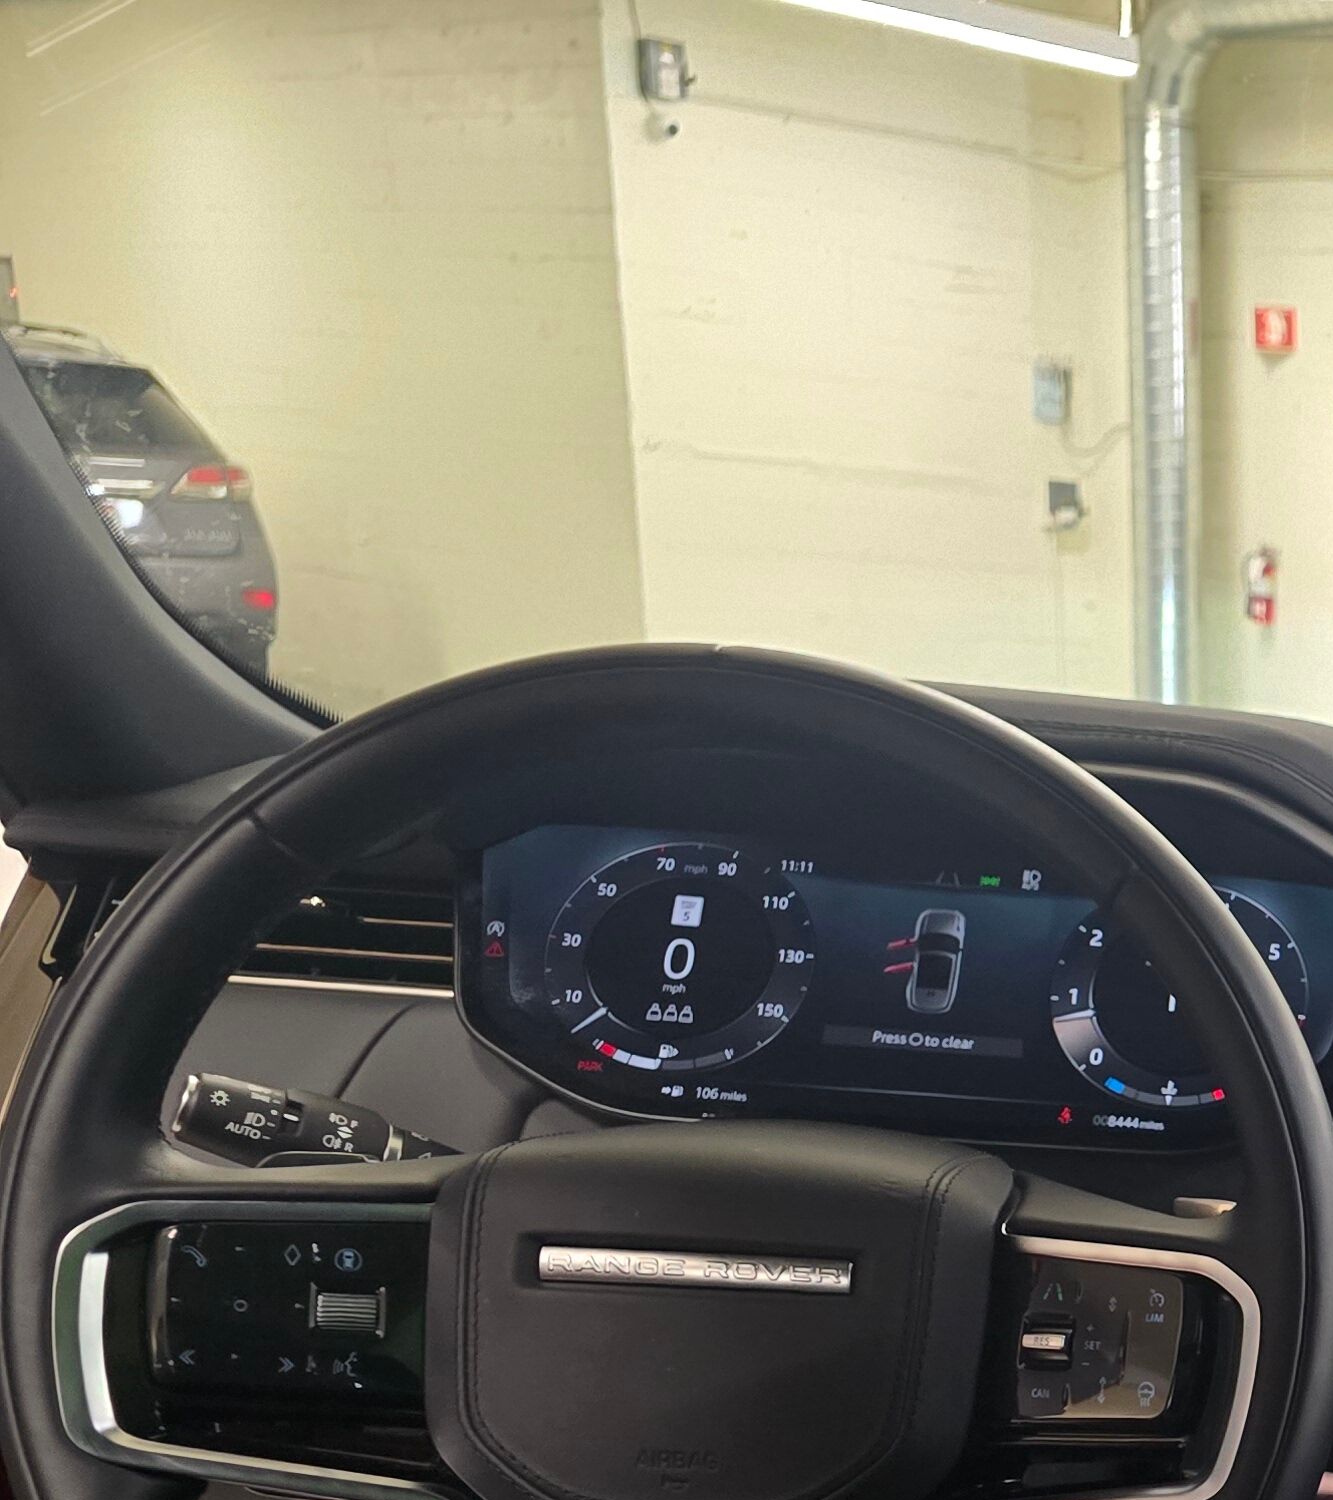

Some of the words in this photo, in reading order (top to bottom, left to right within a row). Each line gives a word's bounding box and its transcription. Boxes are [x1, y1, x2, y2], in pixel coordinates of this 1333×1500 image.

[656, 857, 675, 871] 70
[684, 862, 708, 875] mph
[717, 862, 737, 877] 90
[780, 858, 814, 874] 11:11
[597, 883, 617, 897] 50
[762, 895, 789, 911] 110
[561, 933, 582, 947] 30
[1089, 929, 1103, 947] 2
[663, 937, 696, 981] 0
[778, 949, 805, 964] 130
[1268, 943, 1281, 961] 5
[564, 989, 583, 1004] 10
[662, 983, 687, 995] mph
[1069, 988, 1077, 1005] 1
[756, 1003, 784, 1018] 150
[872, 1030, 907, 1046] Press
[925, 1036, 939, 1048] to
[942, 1036, 975, 1050] clear
[1089, 1048, 1104, 1066] 0
[695, 1086, 719, 1100] 106
[720, 1091, 747, 1103] miles
[224, 1121, 262, 1141] AUTO
[545, 1252, 687, 1278] RANGE
[702, 1259, 844, 1285] ROVER
[1145, 1313, 1165, 1323] LIM
[1083, 1340, 1101, 1352] SET
[1031, 1387, 1051, 1399] CAN
[634, 1448, 722, 1472] AIRBAG
